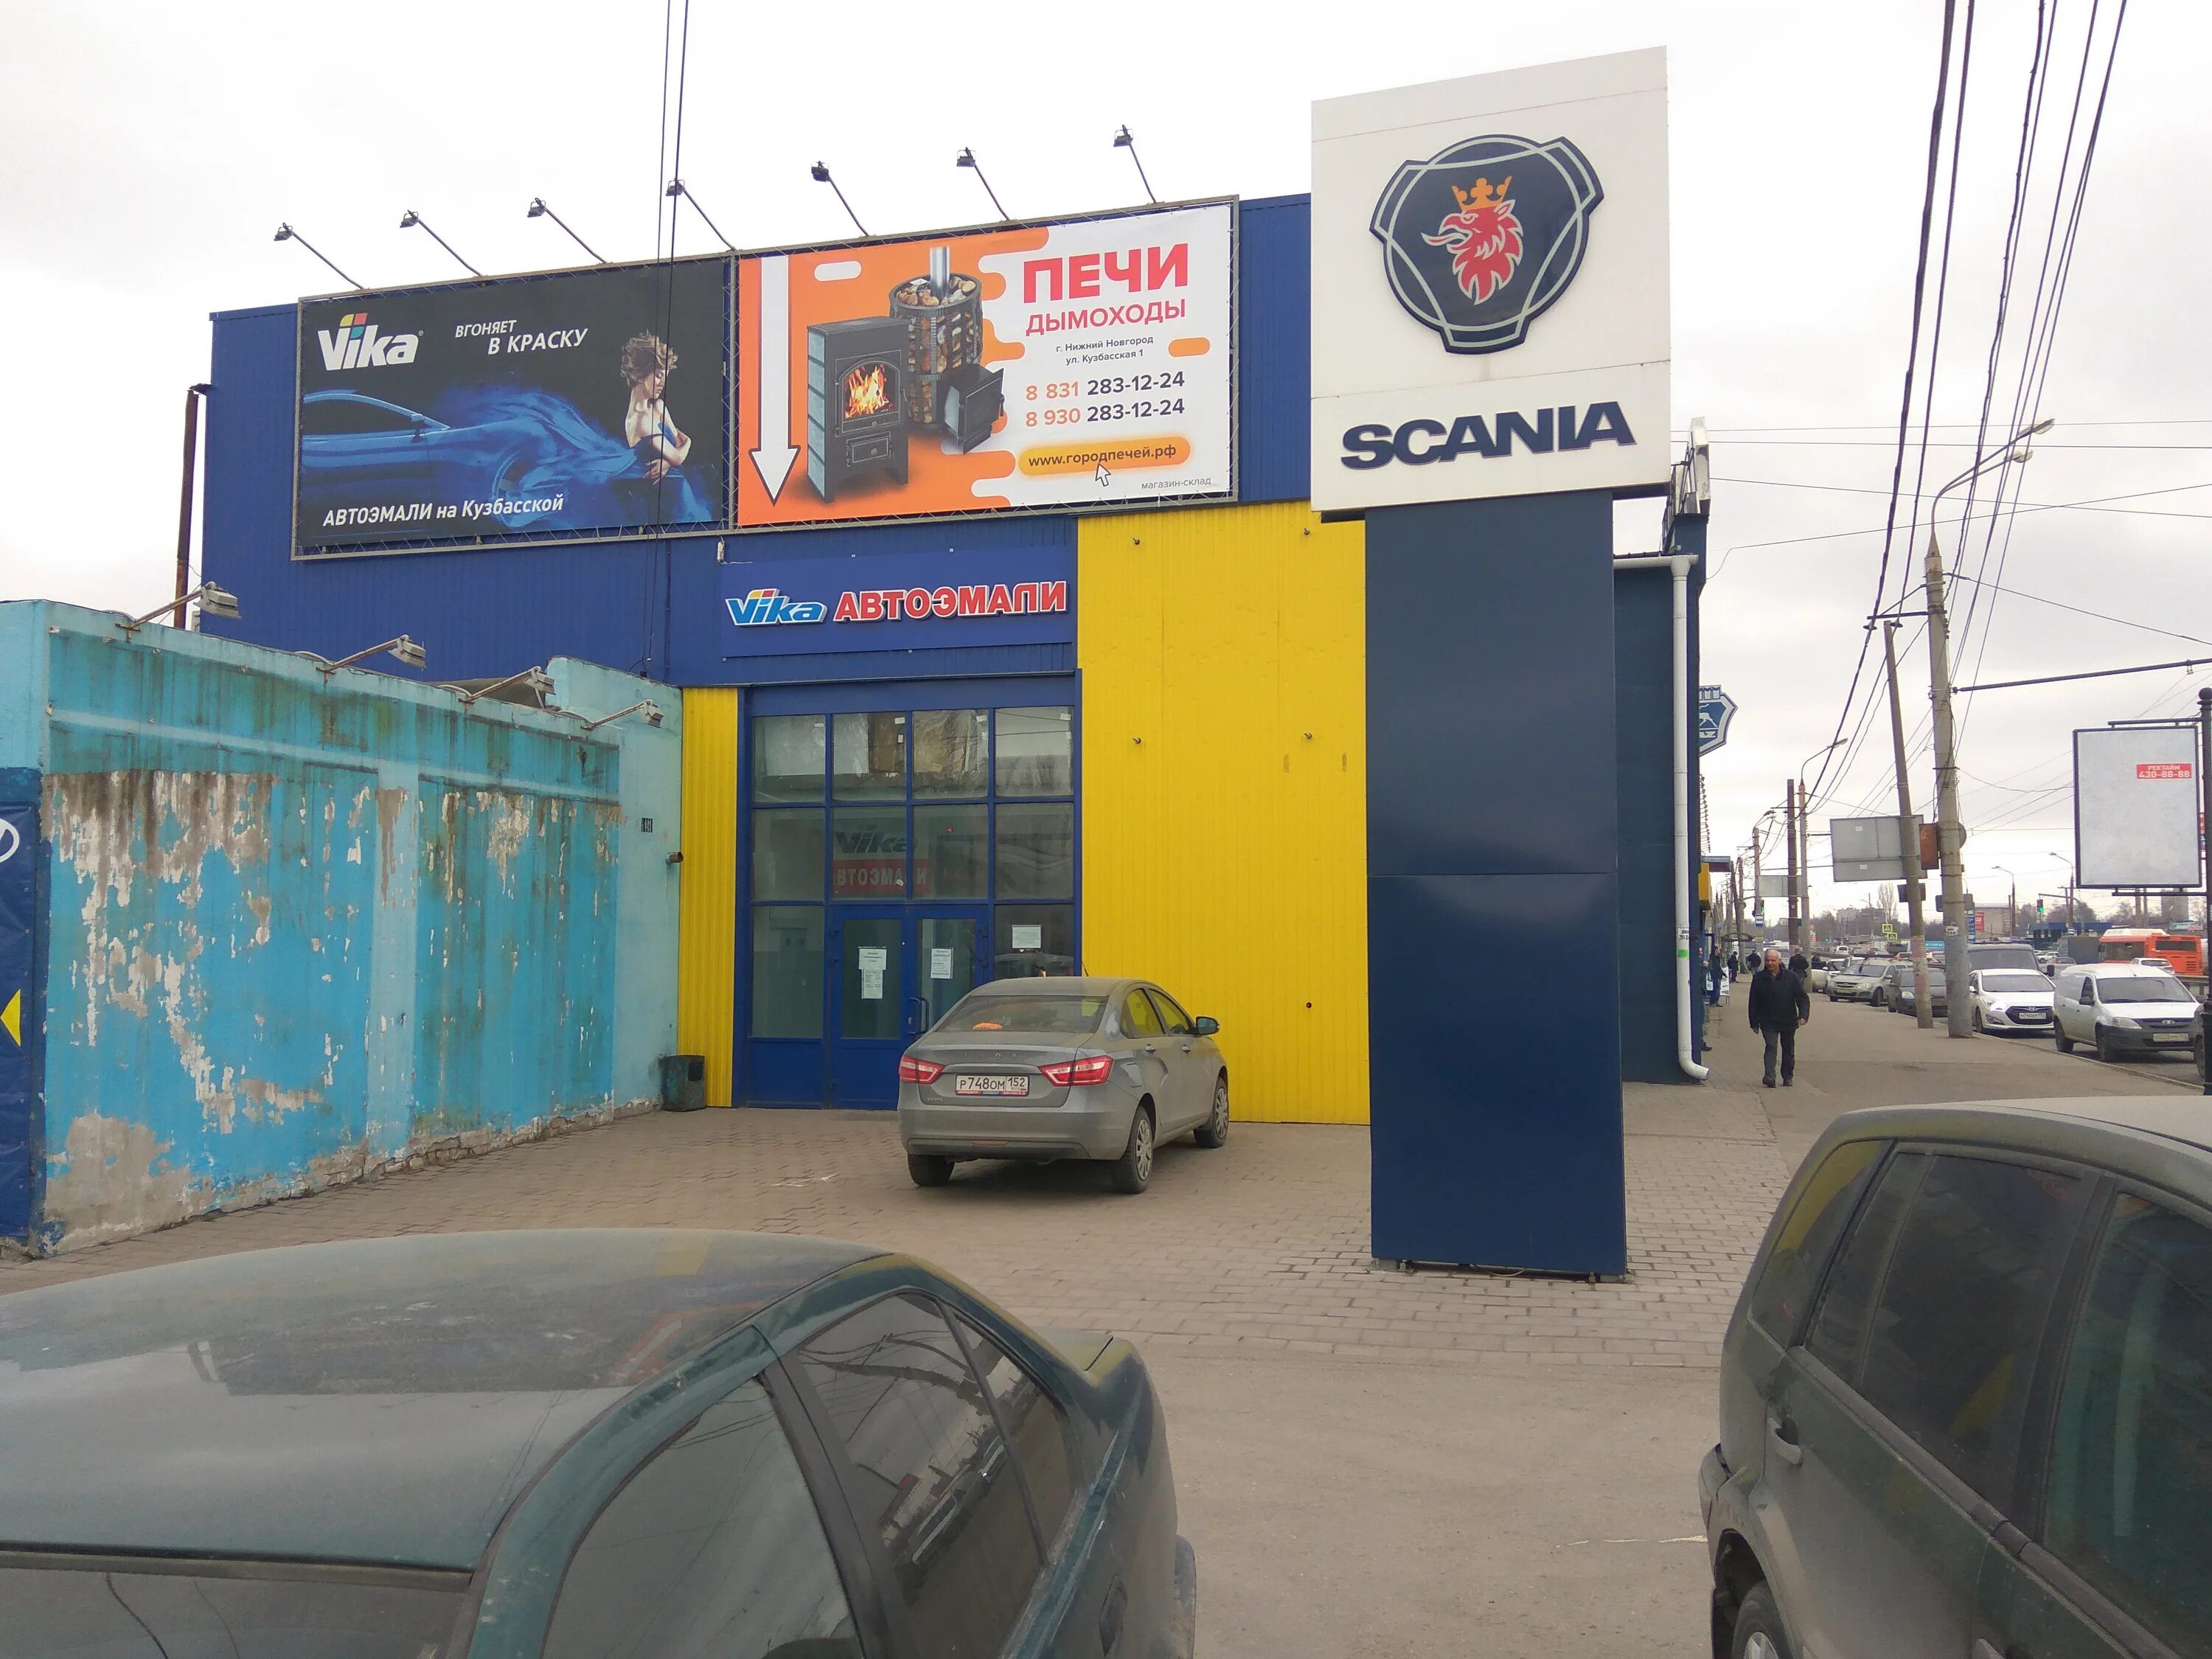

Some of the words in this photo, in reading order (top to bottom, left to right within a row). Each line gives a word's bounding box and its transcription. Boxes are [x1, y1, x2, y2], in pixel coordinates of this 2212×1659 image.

[1023, 243, 1189, 304] ПЕЧИ
[455, 319, 517, 338] ВГОНЯЕТ
[1026, 298, 1186, 337] ДЫМОХОДЫ
[317, 313, 420, 371] Vika
[487, 337, 501, 355] В
[507, 328, 588, 353] КРАСКУ
[1065, 340, 1104, 352] Нижний
[1105, 335, 1154, 348] Новгород
[1065, 356, 1080, 366] ул.
[1082, 350, 1136, 364] Кузбасская
[1138, 349, 1144, 357] 1
[1026, 385, 1038, 401] 8
[1046, 381, 1079, 399] 831
[1087, 371, 1186, 396] 283-12-24
[1026, 411, 1038, 428] 8
[1043, 408, 1081, 425] 930
[1087, 398, 1186, 422] 283-12-24
[1340, 400, 1638, 470] SCANIA
[1028, 445, 1177, 467] www.городпечей.рф
[1141, 477, 1211, 490] магазин-склад
[323, 503, 433, 526] АВТОЭМАЛИ
[437, 504, 456, 519] на
[462, 494, 564, 521] Кузбасской
[725, 588, 827, 626] Vika
[833, 580, 1067, 622] АВТОЭМАЛИ
[1008, 1077, 1026, 1087] 152
